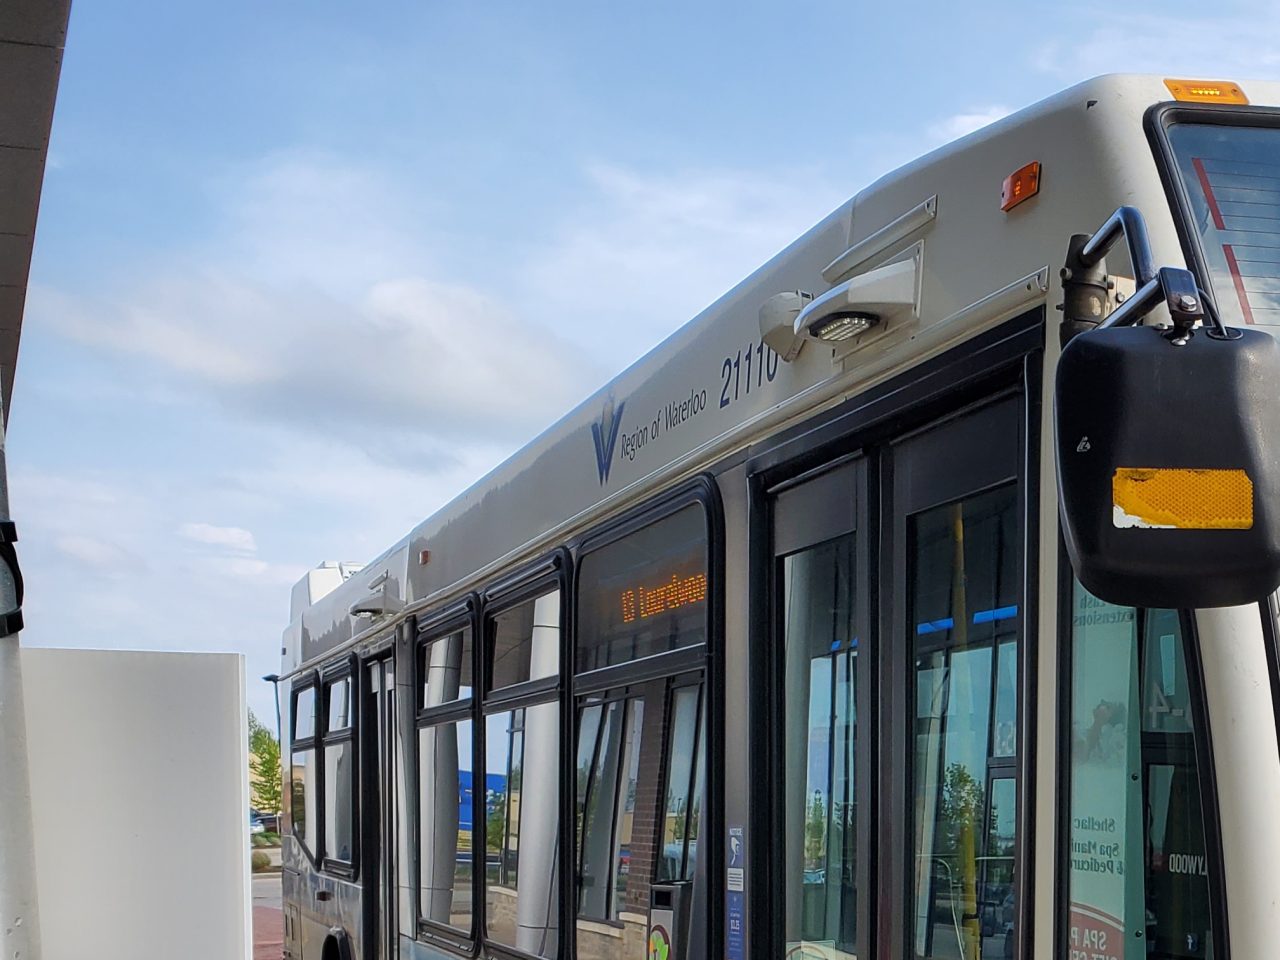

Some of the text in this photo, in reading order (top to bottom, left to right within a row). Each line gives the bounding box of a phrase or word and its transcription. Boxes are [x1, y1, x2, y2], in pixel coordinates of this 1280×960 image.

[621, 388, 707, 460] Region of Waterloo
